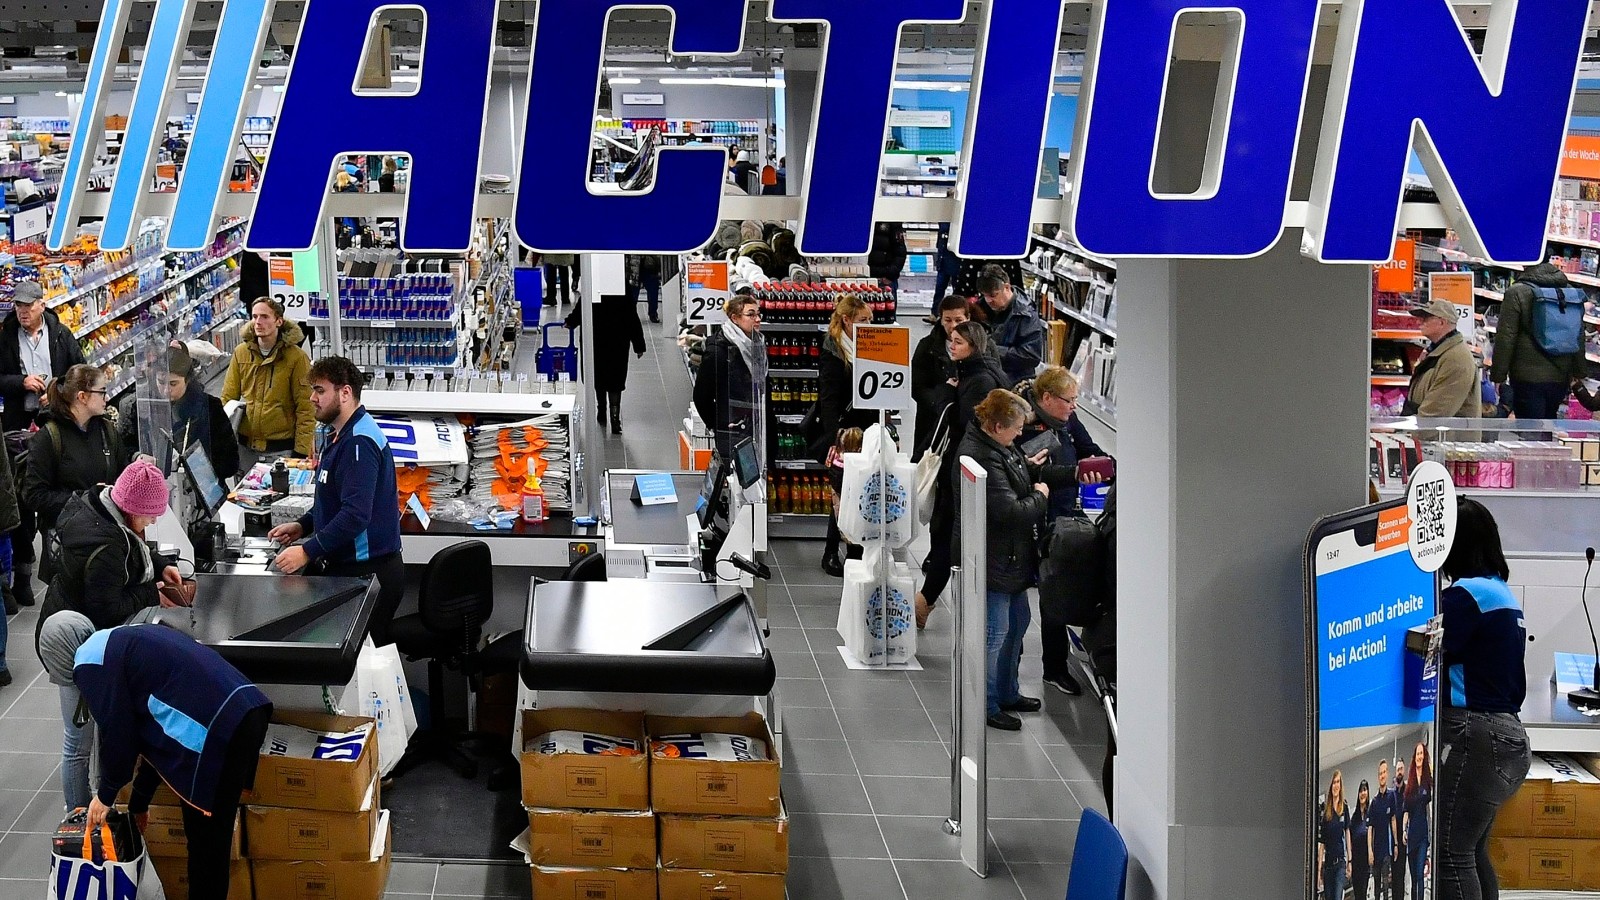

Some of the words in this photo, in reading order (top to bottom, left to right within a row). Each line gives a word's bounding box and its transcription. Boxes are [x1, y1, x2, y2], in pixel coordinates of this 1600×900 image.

[244, 0, 1590, 264] ACTION
[1569, 149, 1579, 159] der
[1580, 149, 1600, 160] Woche
[869, 493, 899, 503] ACON
[1379, 519, 1399, 531] Scannen
[1398, 514, 1408, 525] und
[1377, 530, 1401, 543] bewerben
[1326, 549, 1340, 561] 13:47
[1417, 543, 1446, 559] action.jobs
[874, 607, 903, 617] ACION
[1328, 616, 1362, 640] Komm
[1364, 603, 1384, 628] und
[1387, 594, 1424, 620] arbeite
[1328, 647, 1346, 672] bei
[1348, 635, 1387, 665] Action!
